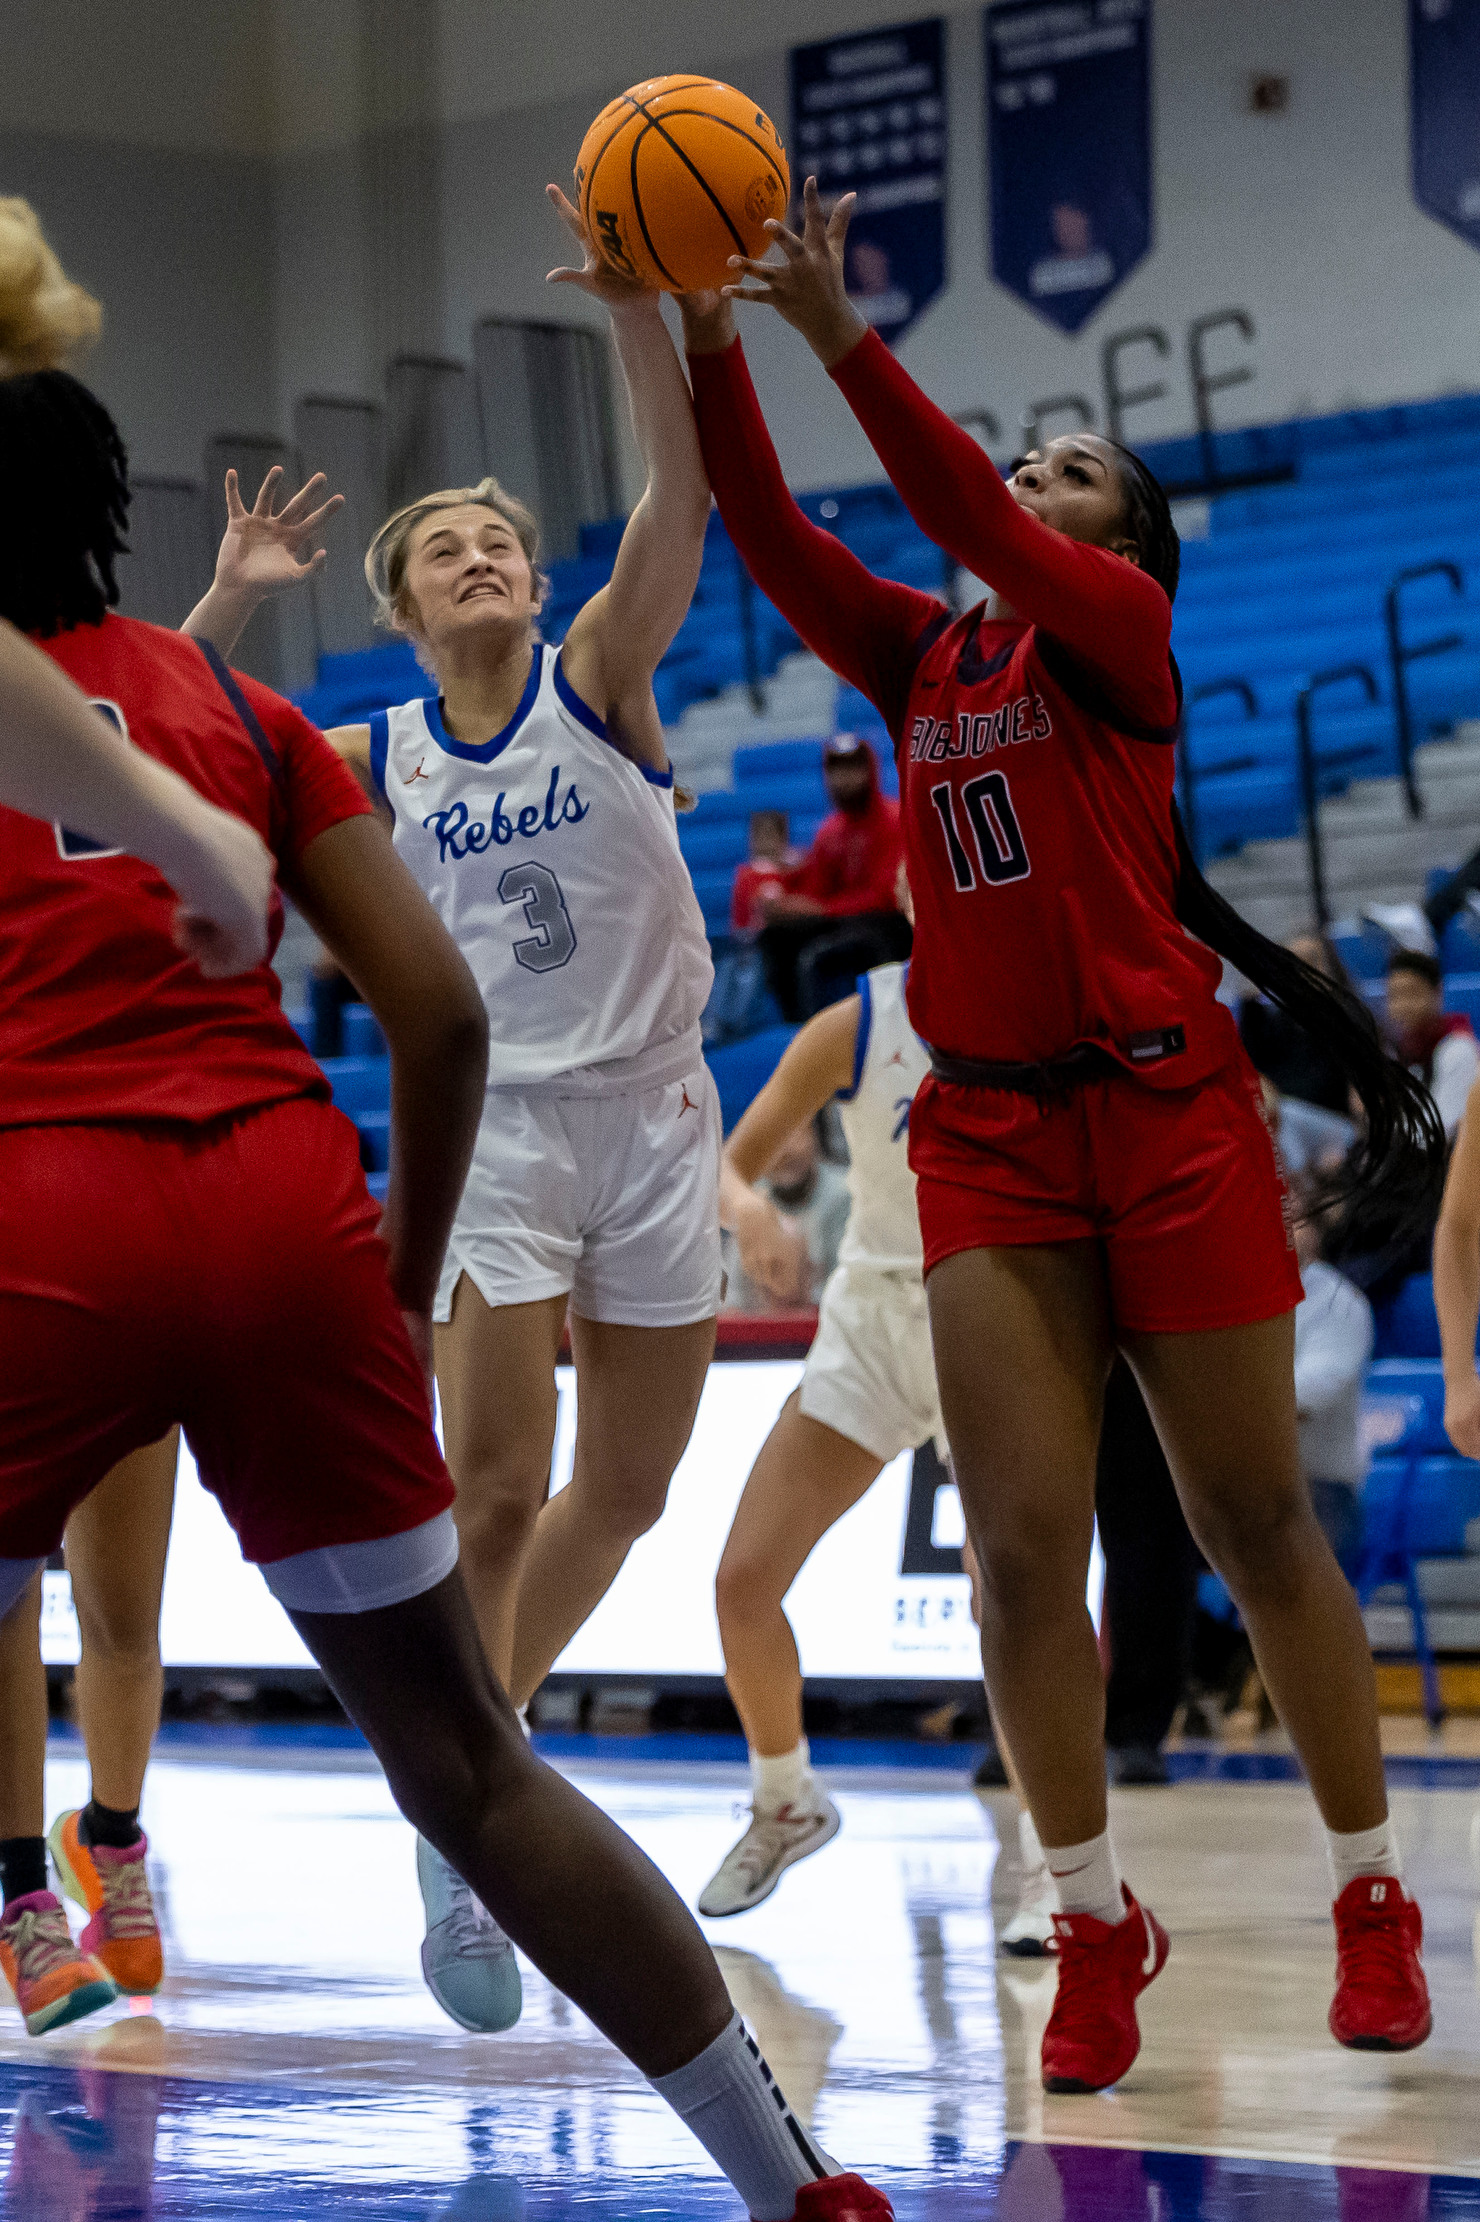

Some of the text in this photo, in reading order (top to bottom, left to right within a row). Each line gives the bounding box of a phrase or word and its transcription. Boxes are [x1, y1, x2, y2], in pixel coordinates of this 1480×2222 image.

[423, 766, 590, 863] Rebels
[930, 769, 1031, 892] 10
[497, 860, 577, 974] 3
